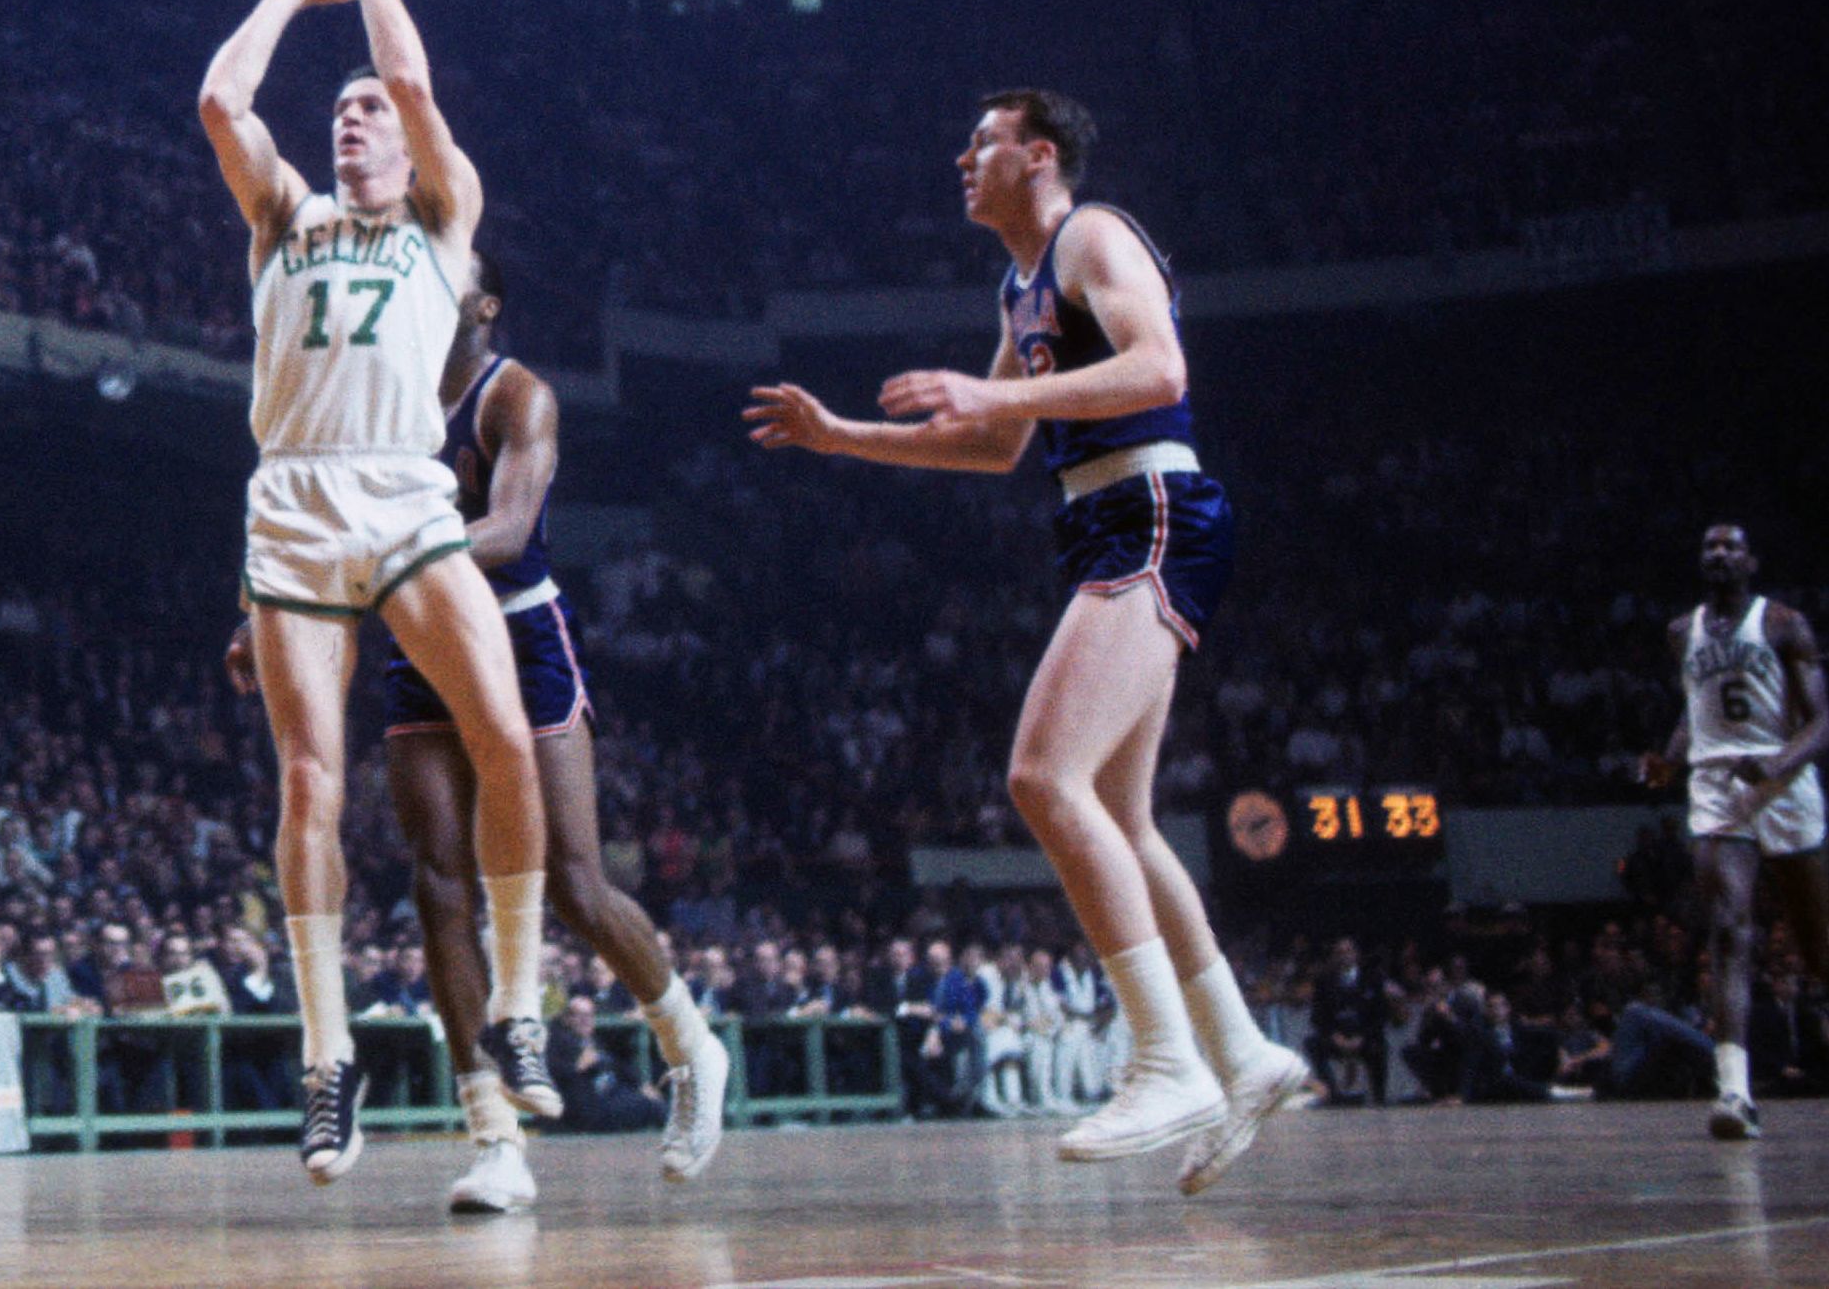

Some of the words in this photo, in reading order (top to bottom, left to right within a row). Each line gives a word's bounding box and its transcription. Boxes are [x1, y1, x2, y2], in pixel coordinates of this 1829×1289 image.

[281, 218, 423, 278] CELTICS
[302, 278, 395, 349] 17
[1721, 681, 1751, 722] 6
[1308, 794, 1365, 840] 31
[1381, 793, 1441, 838] 33
